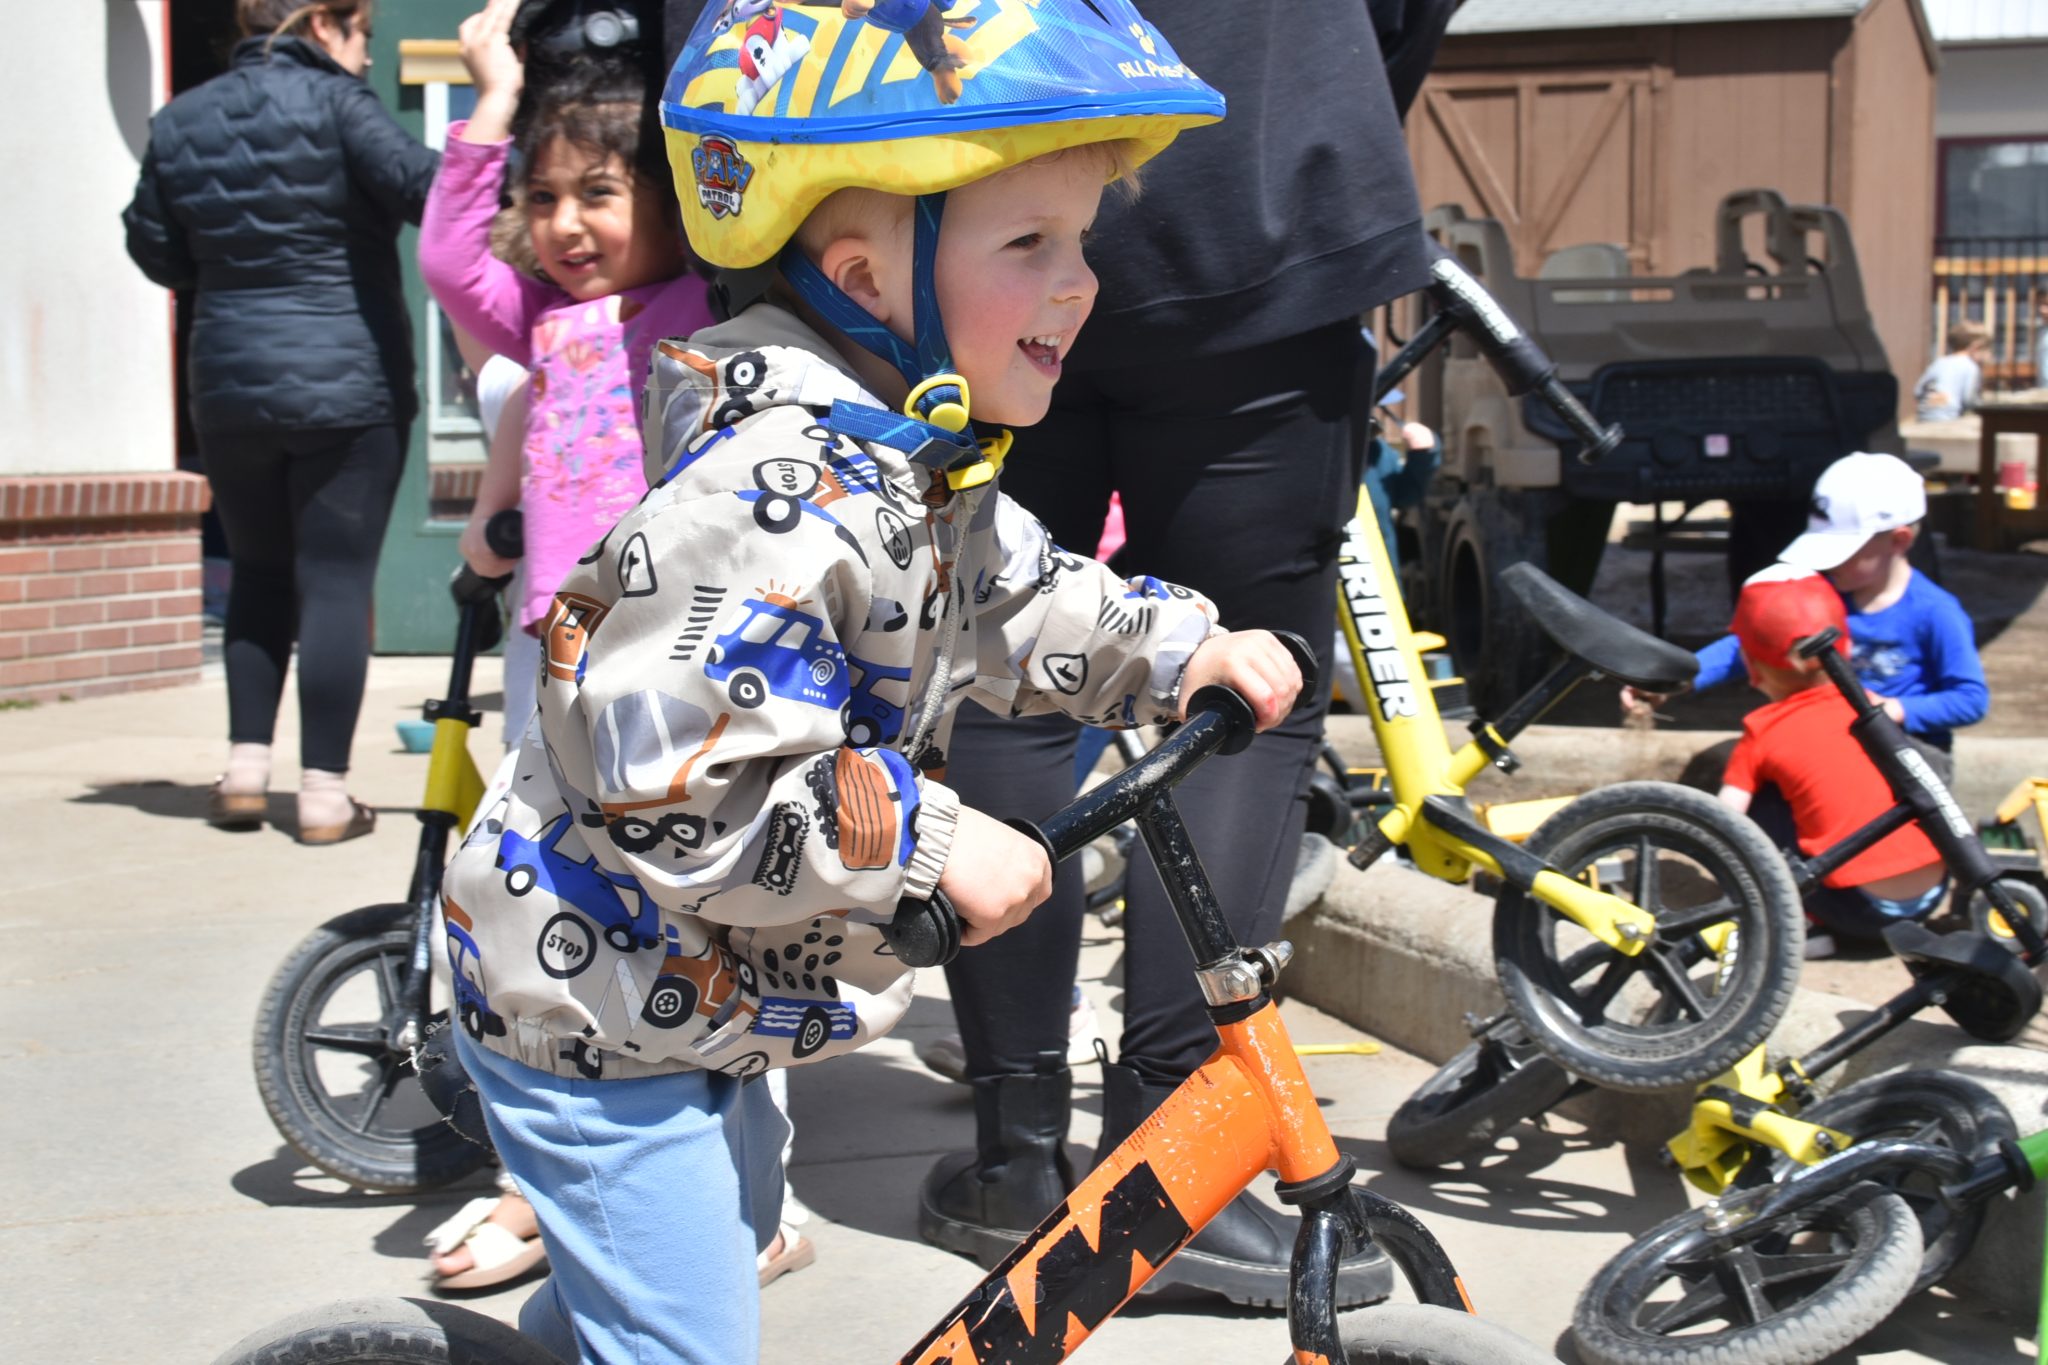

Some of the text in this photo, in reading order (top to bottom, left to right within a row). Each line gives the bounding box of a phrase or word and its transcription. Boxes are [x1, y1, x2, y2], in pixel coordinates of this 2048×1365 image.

[1117, 60, 1151, 79] ALL
[692, 147, 755, 192] PAW
[701, 189, 736, 207] PATROL
[777, 462, 798, 491] STOP
[1339, 517, 1418, 723] TRIDER
[547, 933, 583, 960] STOP
[1196, 1068, 1214, 1089] RNING
